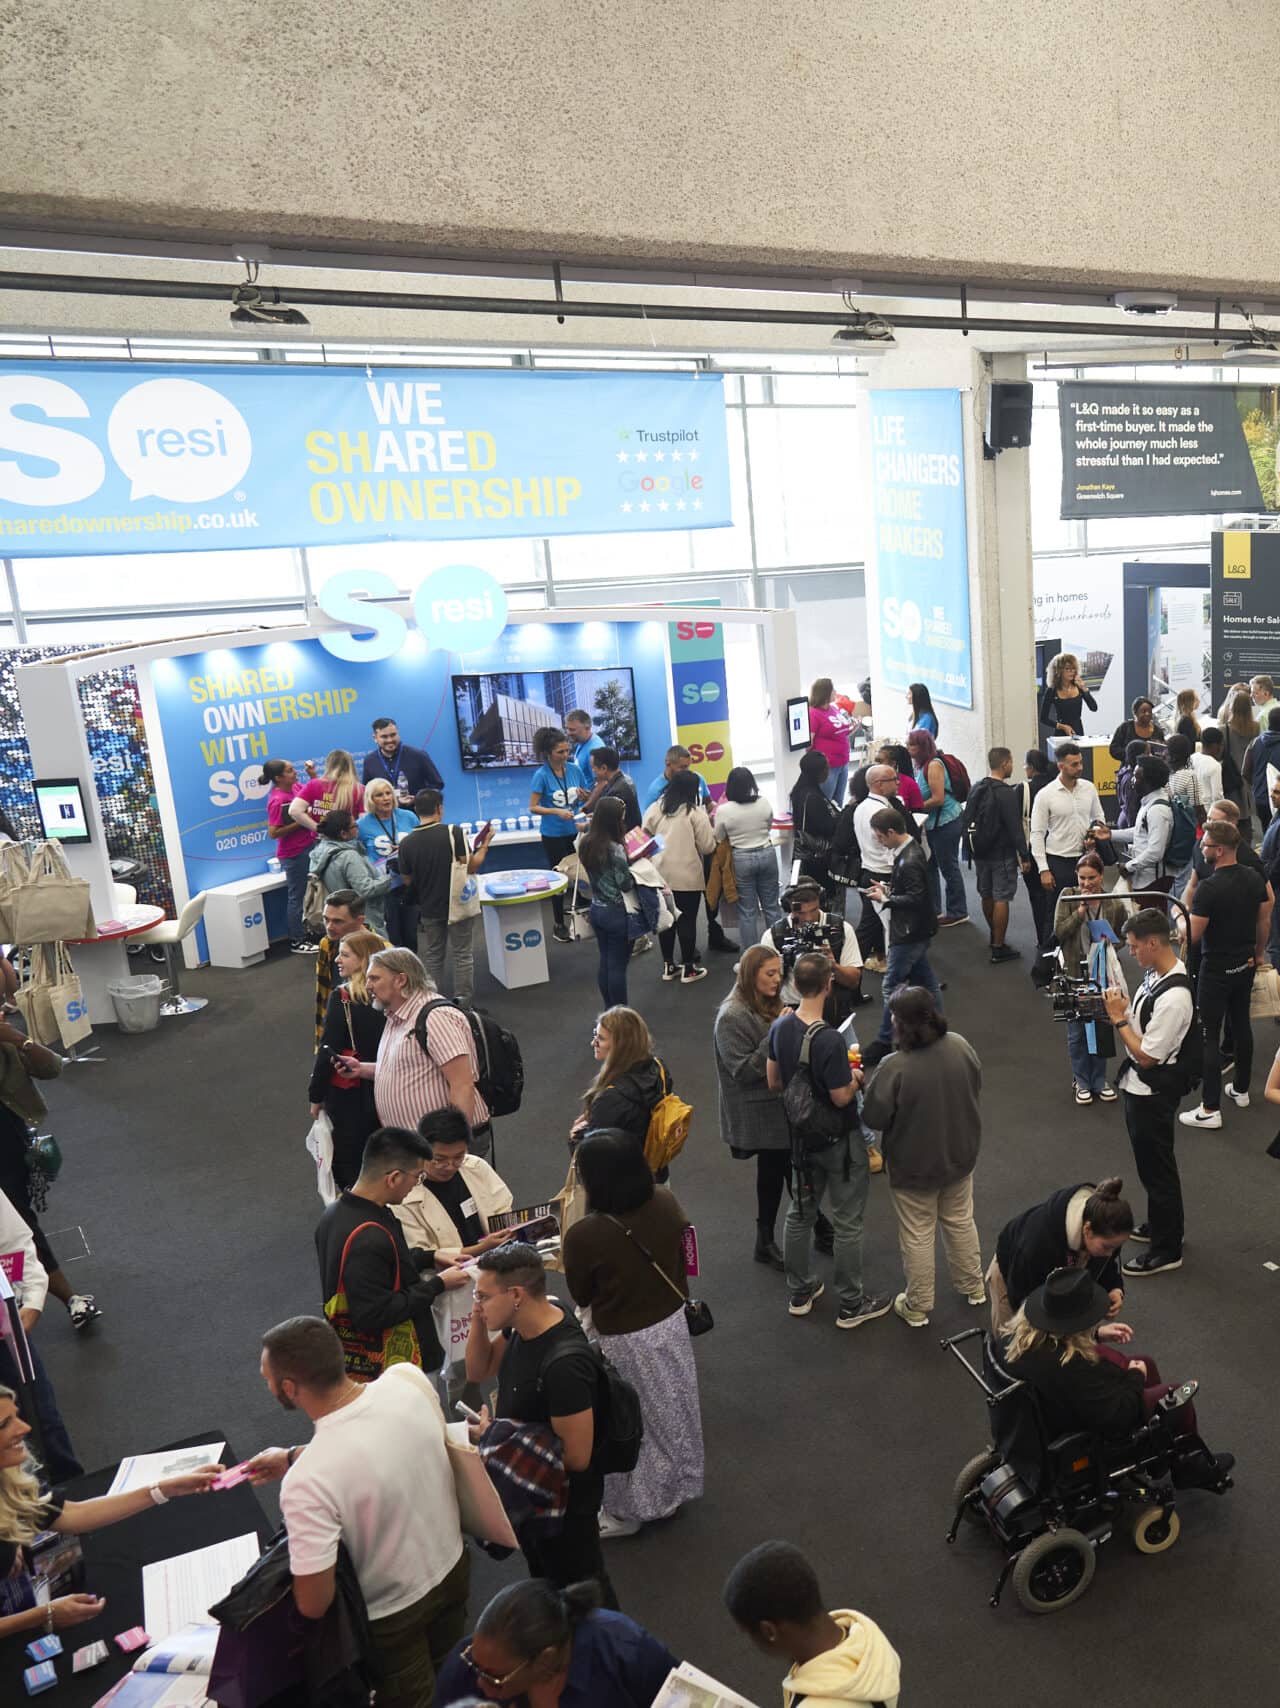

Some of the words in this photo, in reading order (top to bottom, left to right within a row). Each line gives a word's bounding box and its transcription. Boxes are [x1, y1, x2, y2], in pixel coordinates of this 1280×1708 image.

[366, 381, 446, 425] WE
[1102, 403, 1130, 416] made
[1132, 403, 1140, 416] it
[1142, 406, 1154, 416] so
[1156, 406, 1178, 419] easy
[1180, 406, 1191, 416] as
[1193, 406, 1200, 416] a
[137, 418, 227, 457] resi
[636, 428, 699, 444] Trustpilot
[873, 414, 906, 446] LIFE
[1076, 420, 1123, 433] first-time
[1125, 420, 1156, 436] buyer.
[1158, 421, 1166, 432] It
[1168, 421, 1195, 433] made
[1198, 421, 1213, 433] the
[305, 430, 498, 474] SHARED
[1076, 437, 1107, 449] whole
[1109, 437, 1147, 452] journey
[1150, 437, 1177, 449] much
[1180, 437, 1198, 449] less
[875, 450, 961, 487] CHANGERS
[1076, 454, 1119, 466] stressful
[1122, 454, 1144, 466] than
[1152, 454, 1171, 466] had
[618, 469, 703, 496] Google
[309, 476, 582, 525] OWNERSHIP
[1227, 564, 1246, 575] L&Q
[432, 590, 494, 624] resi
[1046, 593, 1054, 603] in
[1057, 591, 1089, 603] homes
[1223, 615, 1251, 624] Homes
[1253, 615, 1265, 624] for
[188, 666, 295, 704] SHARED
[203, 687, 358, 734] OWNERSHIP
[200, 731, 269, 767] WITH
[216, 835, 238, 851] 020
[240, 829, 268, 846] 8607
